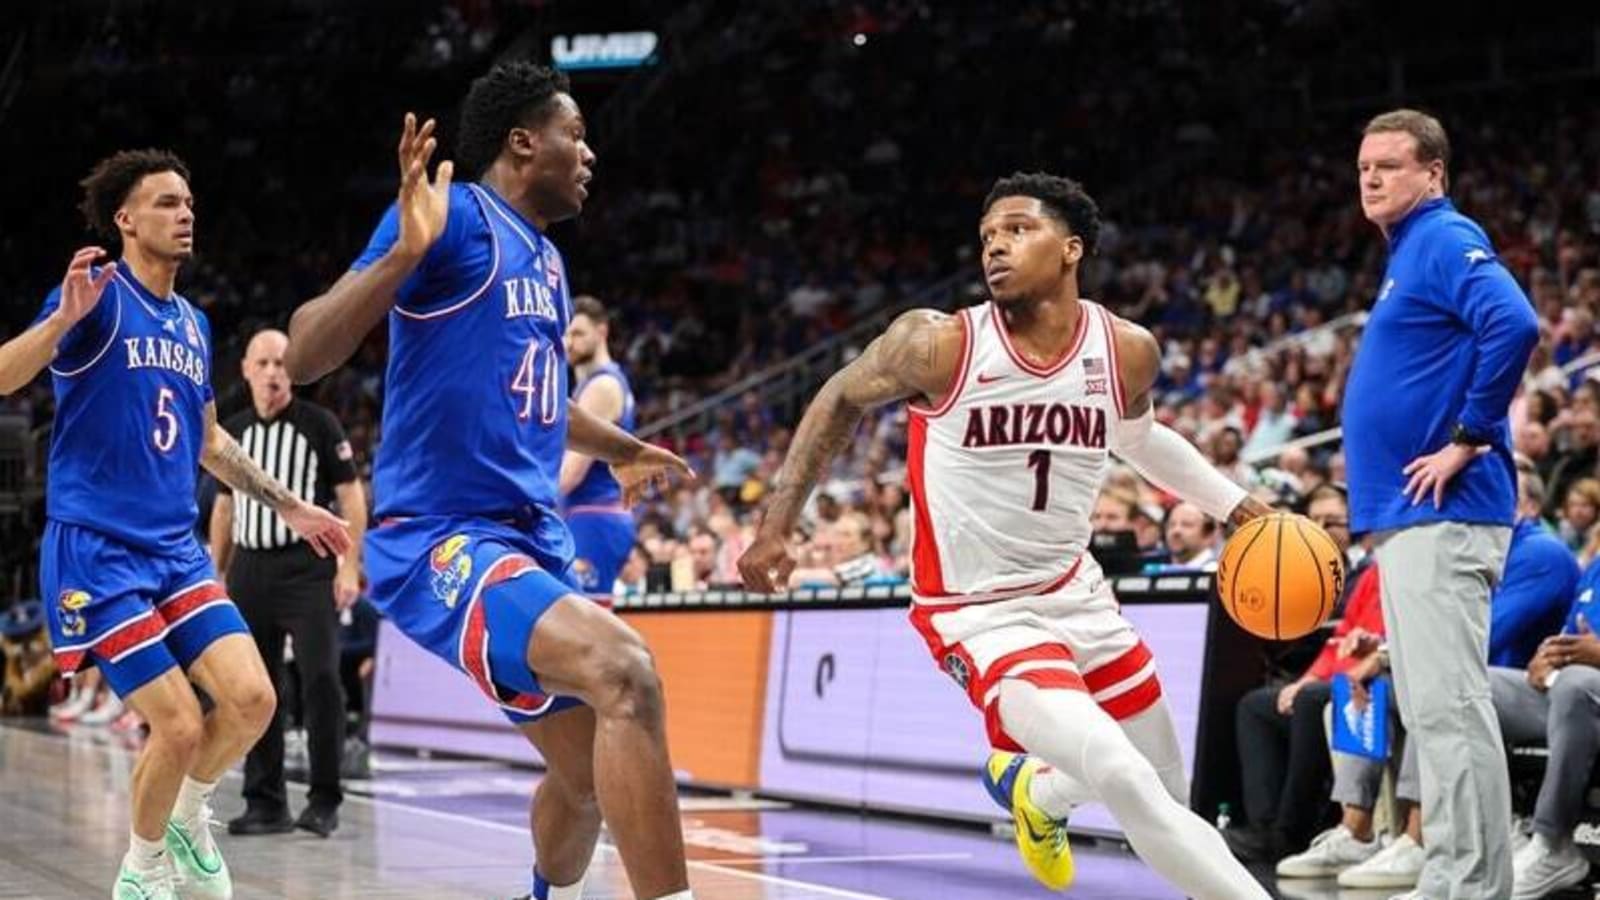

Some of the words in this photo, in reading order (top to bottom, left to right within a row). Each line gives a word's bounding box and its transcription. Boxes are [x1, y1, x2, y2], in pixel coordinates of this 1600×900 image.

[124, 336, 204, 386] KANSAS
[511, 337, 559, 425] 40
[153, 387, 178, 452] 5
[961, 403, 1107, 449] ARIZONA
[1027, 449, 1052, 512] 1
